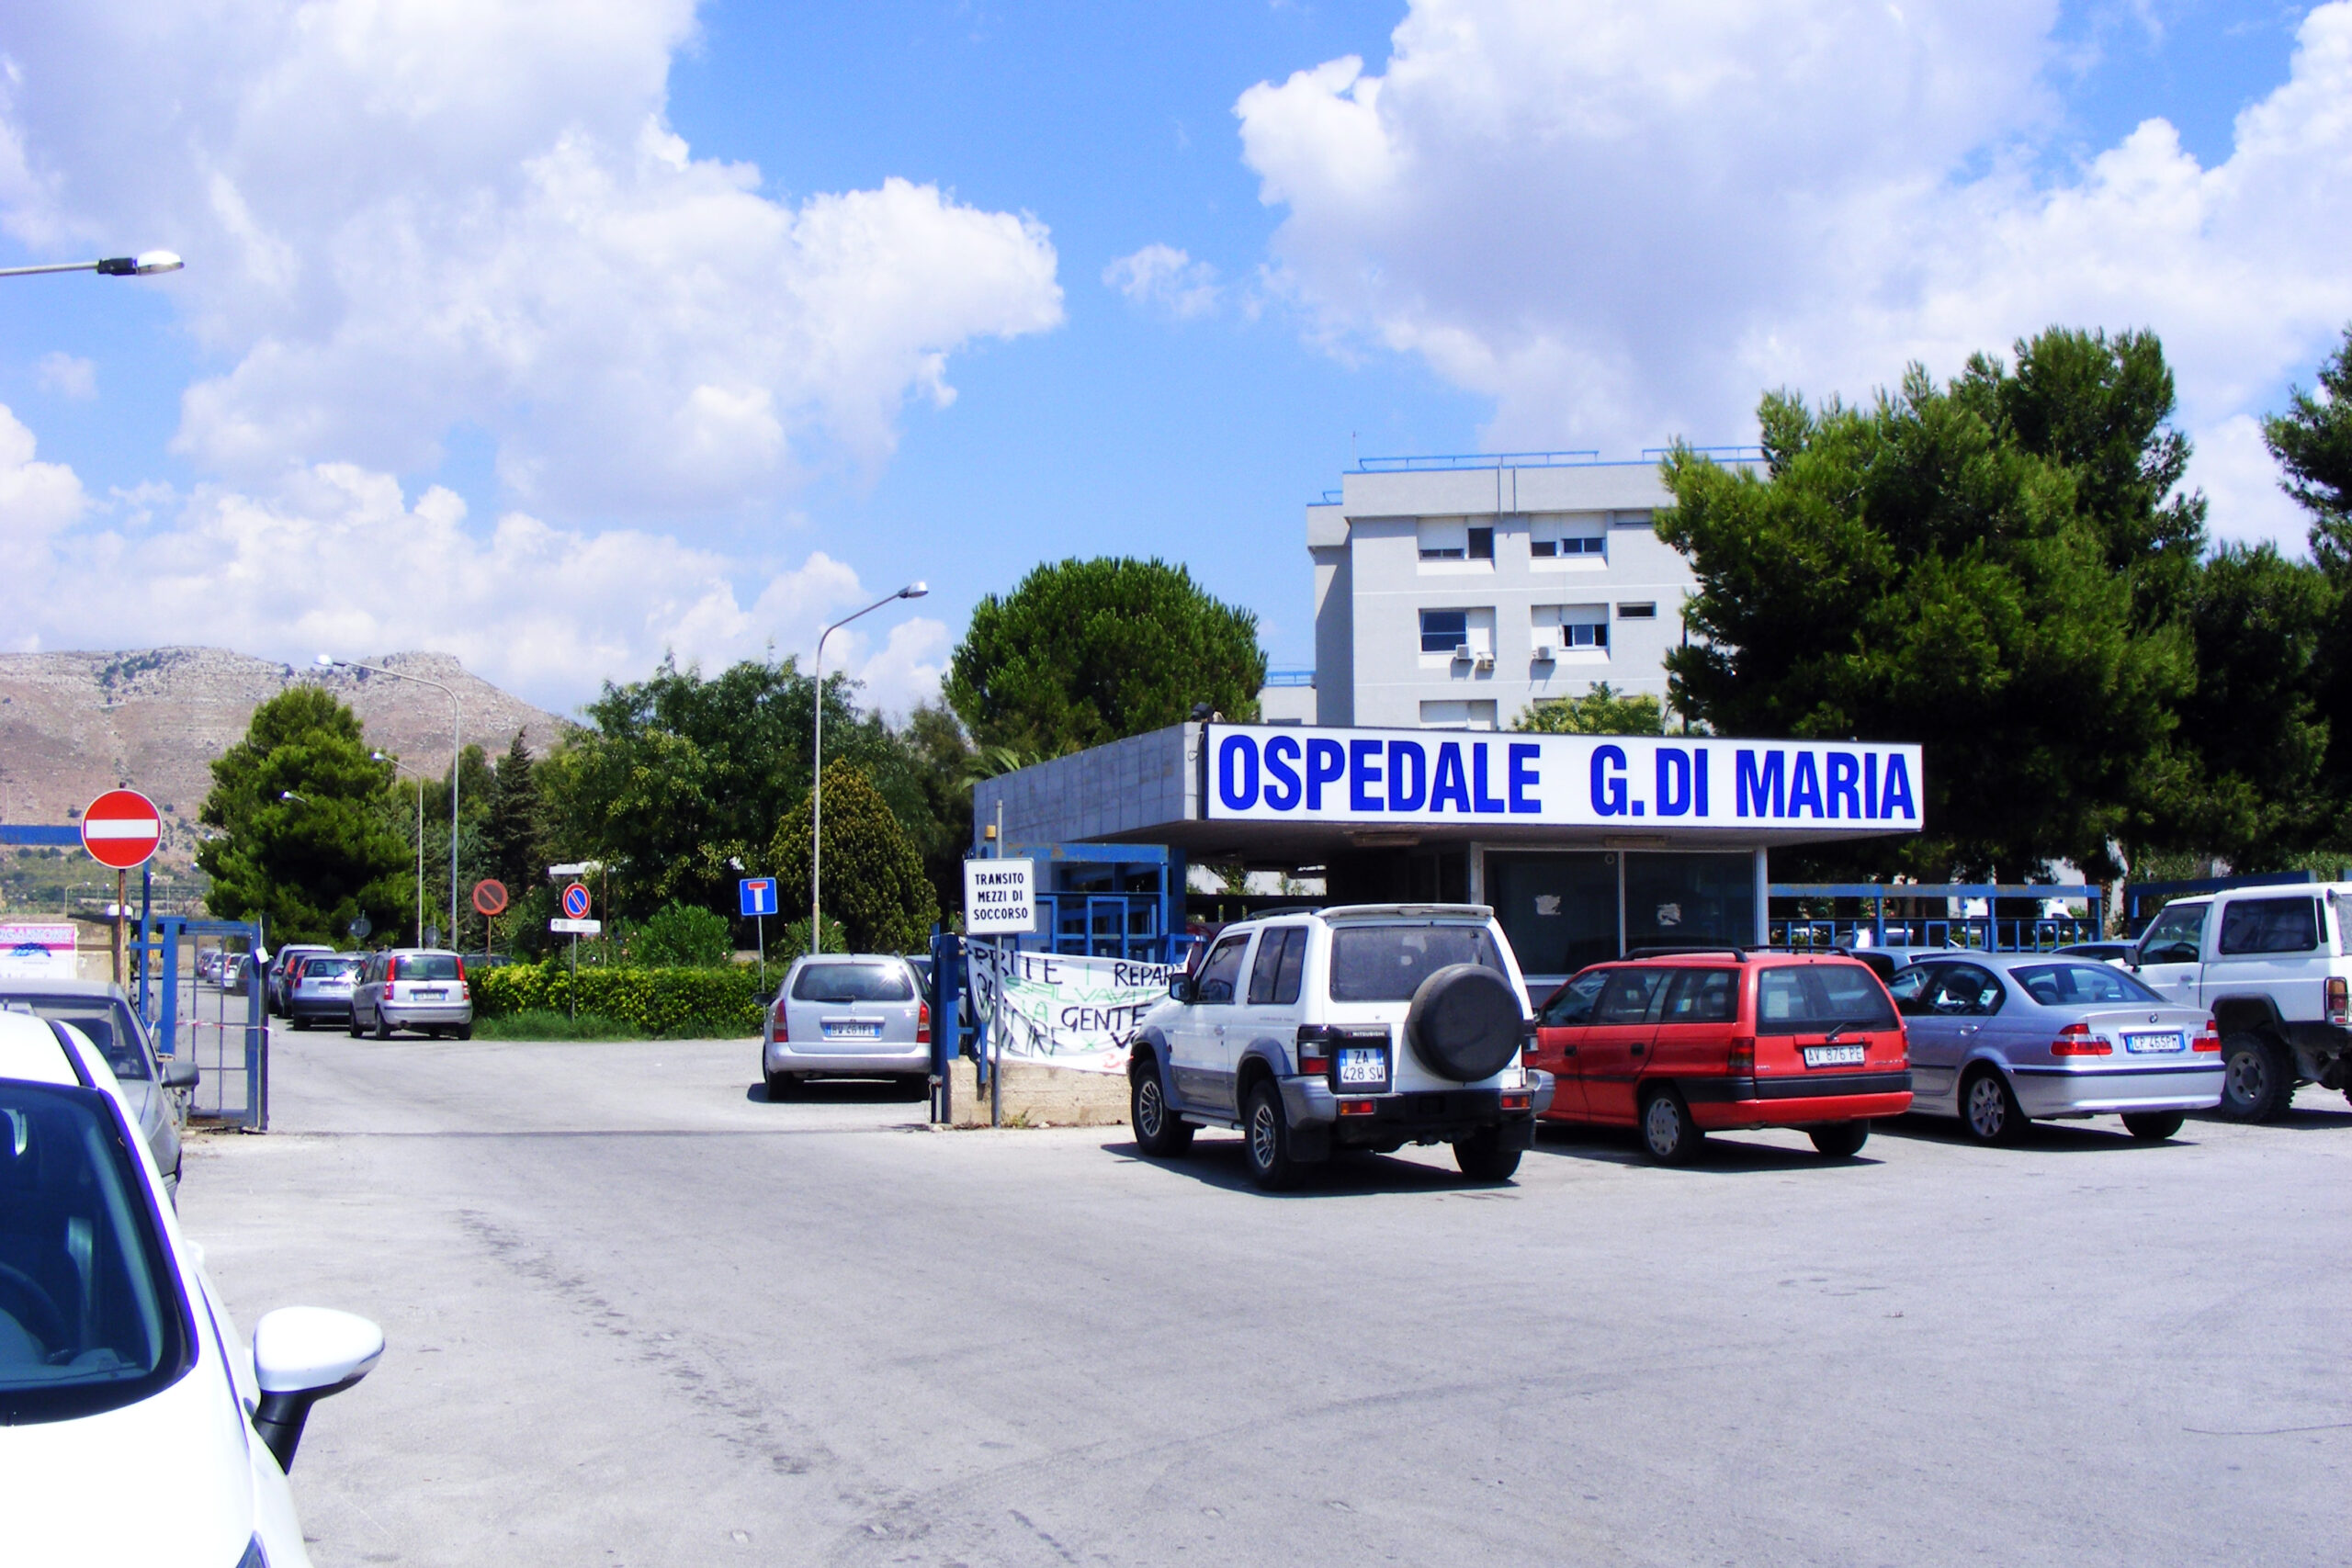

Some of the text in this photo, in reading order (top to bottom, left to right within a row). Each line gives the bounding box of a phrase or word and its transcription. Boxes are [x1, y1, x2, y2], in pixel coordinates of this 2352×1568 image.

[1218, 734, 1542, 814] OSPEDALE
[1736, 750, 1917, 819] MARIA
[975, 873, 1024, 886] TRANSITO
[978, 890, 1023, 903] MEZZI DI
[974, 908, 1028, 920] SOCCORSO
[1114, 962, 1182, 987] REPAR
[1006, 977, 1169, 1004] SALVAVIT
[1061, 1003, 1153, 1032] GENTE
[2134, 1036, 2145, 1048] CP
[1354, 1050, 1369, 1064] ZA
[1808, 1049, 1820, 1062] AV
[1849, 1046, 1862, 1060] PE
[1343, 1066, 1384, 1080] 428 SW
